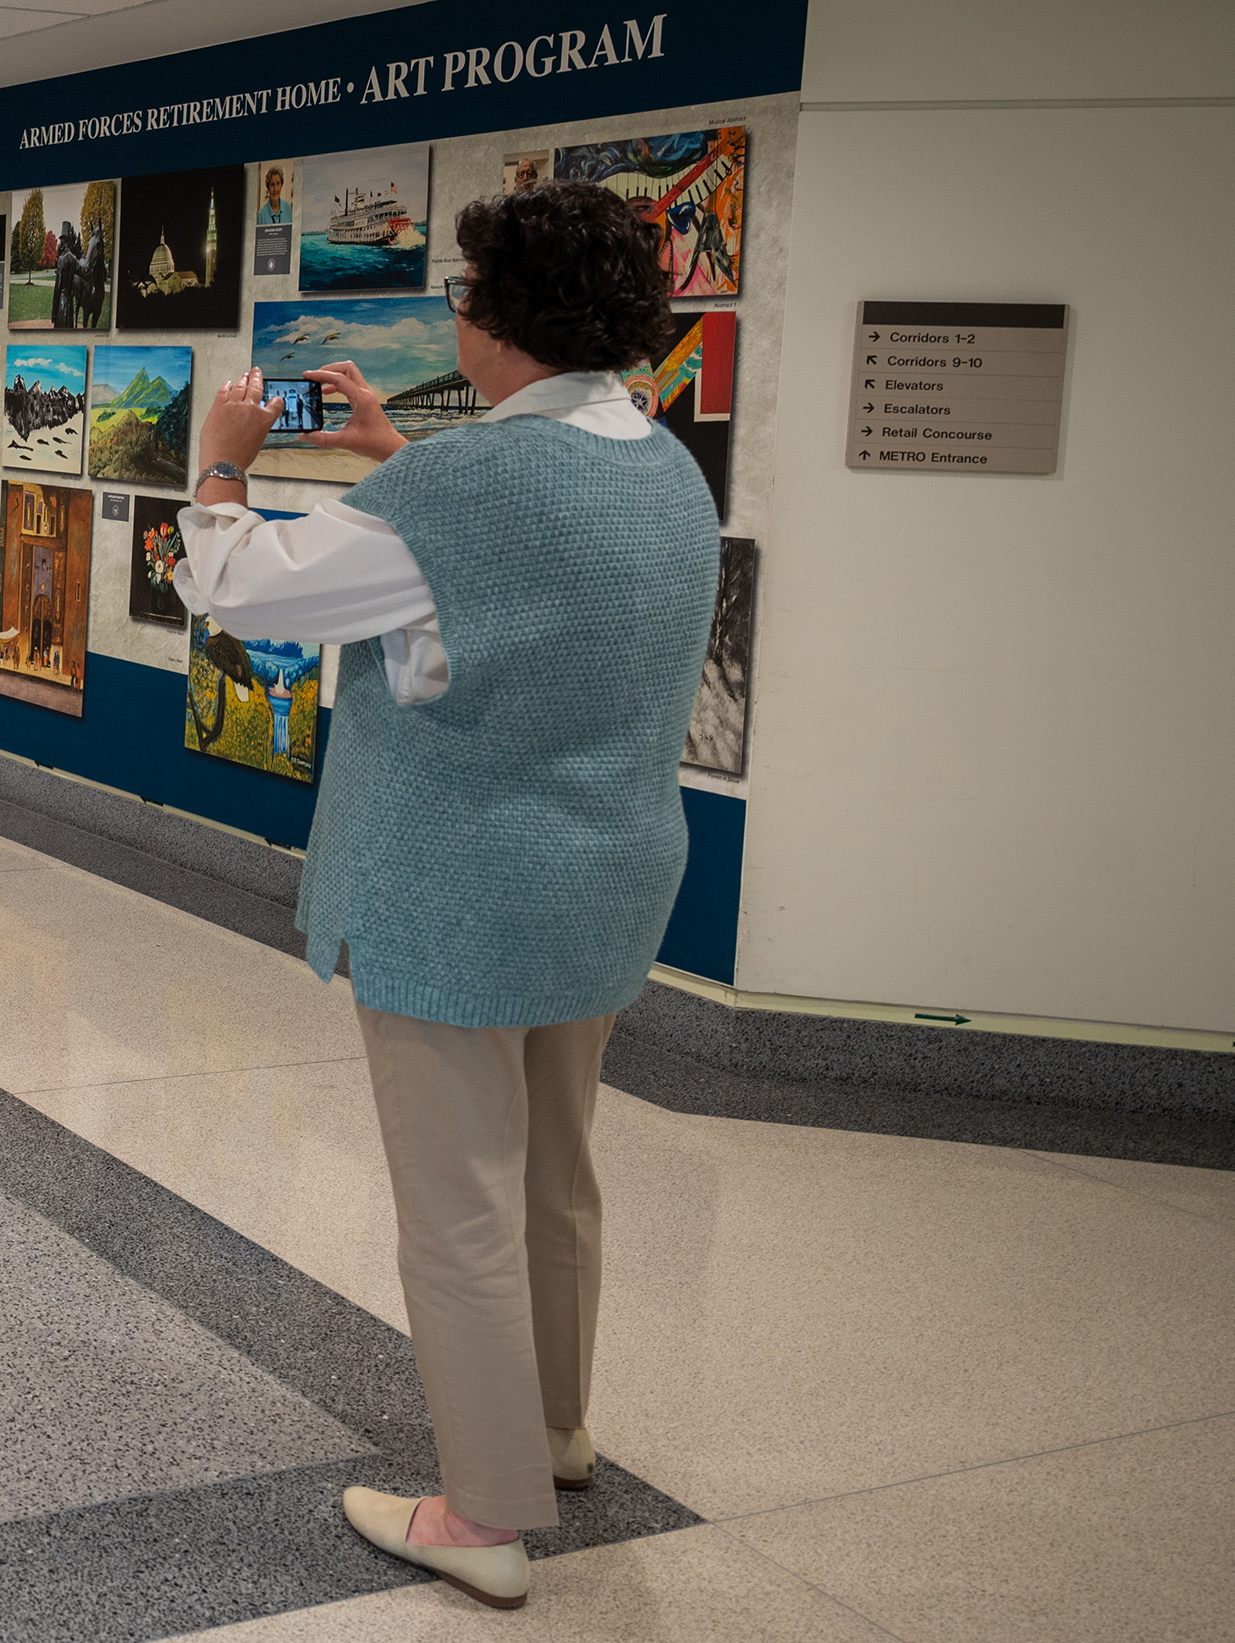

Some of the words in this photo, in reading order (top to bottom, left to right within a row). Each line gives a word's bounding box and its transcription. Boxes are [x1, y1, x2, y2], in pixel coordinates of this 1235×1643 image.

[19, 121, 75, 150] ARMED
[77, 110, 143, 143] FORCES
[145, 88, 271, 131] RETIREMENT
[276, 77, 342, 112] HOME
[360, 54, 436, 105] ART
[440, 13, 668, 92] PROGRAM
[889, 331, 950, 344] Corridors
[954, 333, 976, 345] 1-2
[887, 355, 947, 368] Corridors
[952, 357, 983, 368] 9-10
[885, 380, 944, 391] Elevators
[884, 403, 951, 416] Escalators
[882, 426, 917, 438] Retail
[922, 428, 993, 440] Concourse
[879, 450, 926, 462] METRO
[931, 452, 988, 464] Entrance
